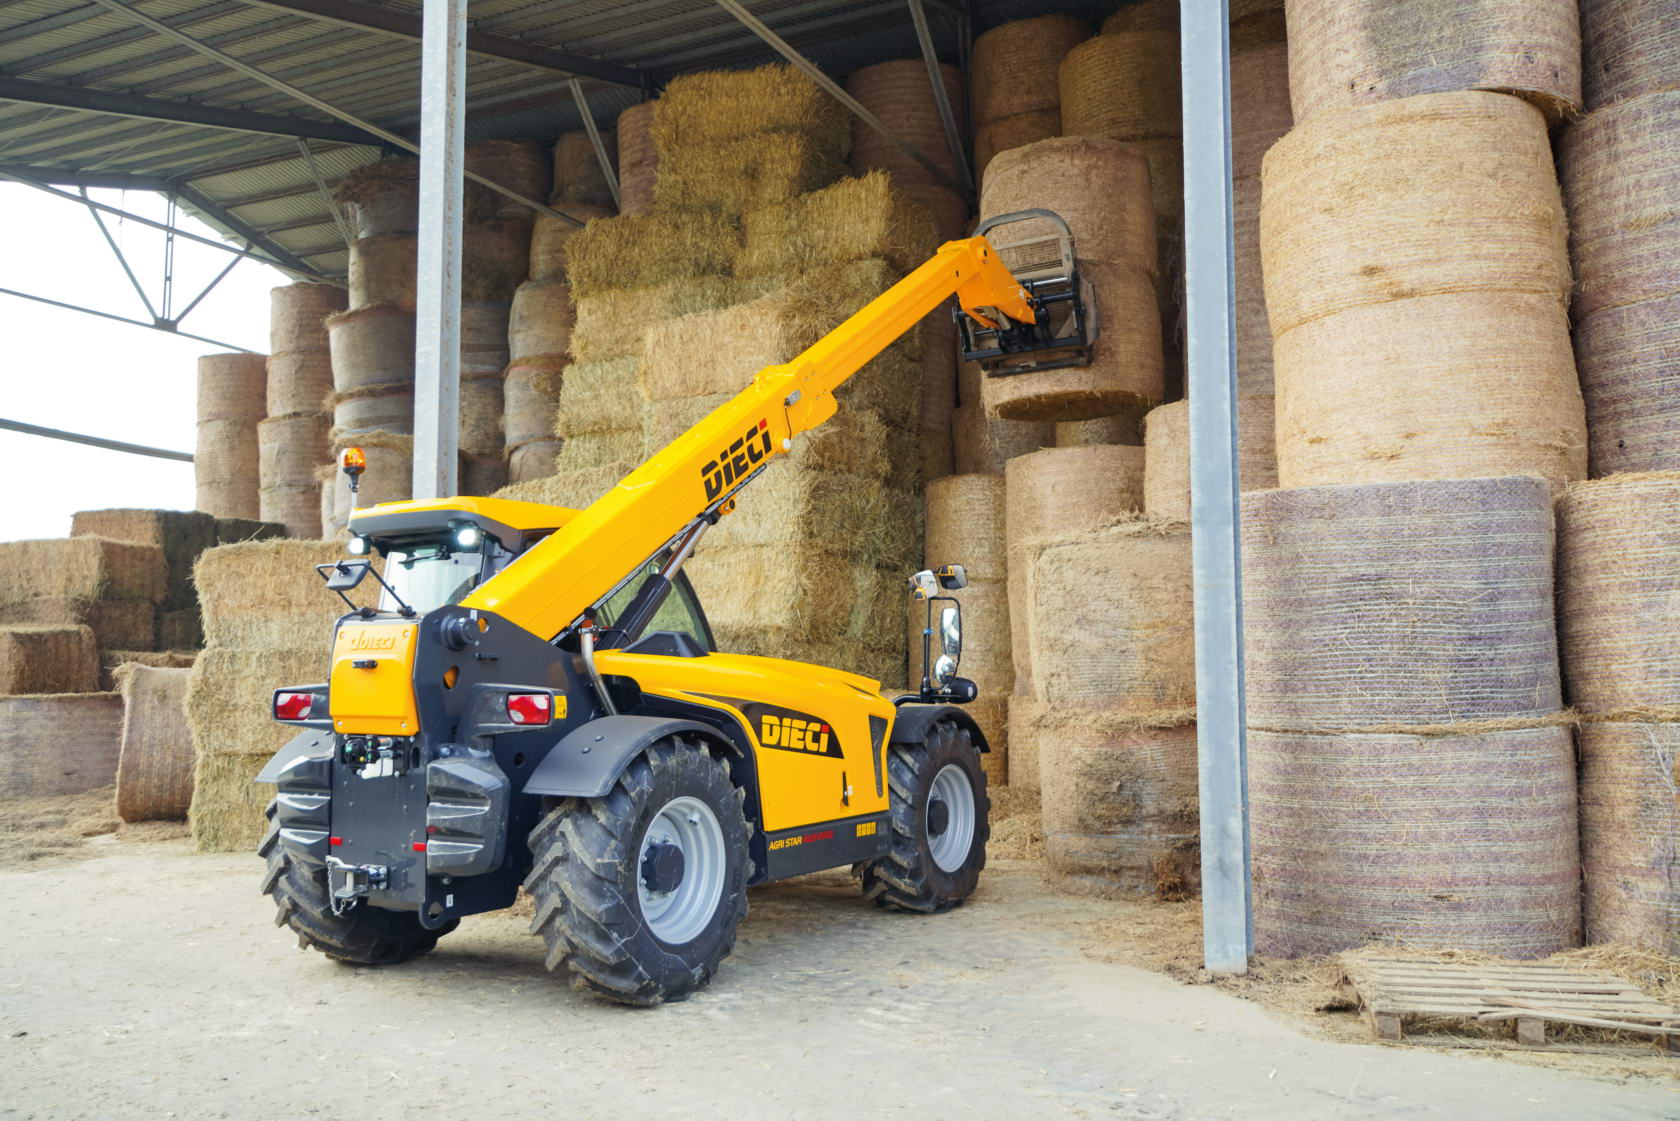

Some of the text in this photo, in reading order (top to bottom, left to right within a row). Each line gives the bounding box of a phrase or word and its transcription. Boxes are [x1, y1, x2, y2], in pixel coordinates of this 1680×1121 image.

[701, 418, 772, 502] DIECI
[762, 715, 829, 752] DIECI
[769, 839, 785, 851] AGRI
[785, 836, 802, 848] STAR
